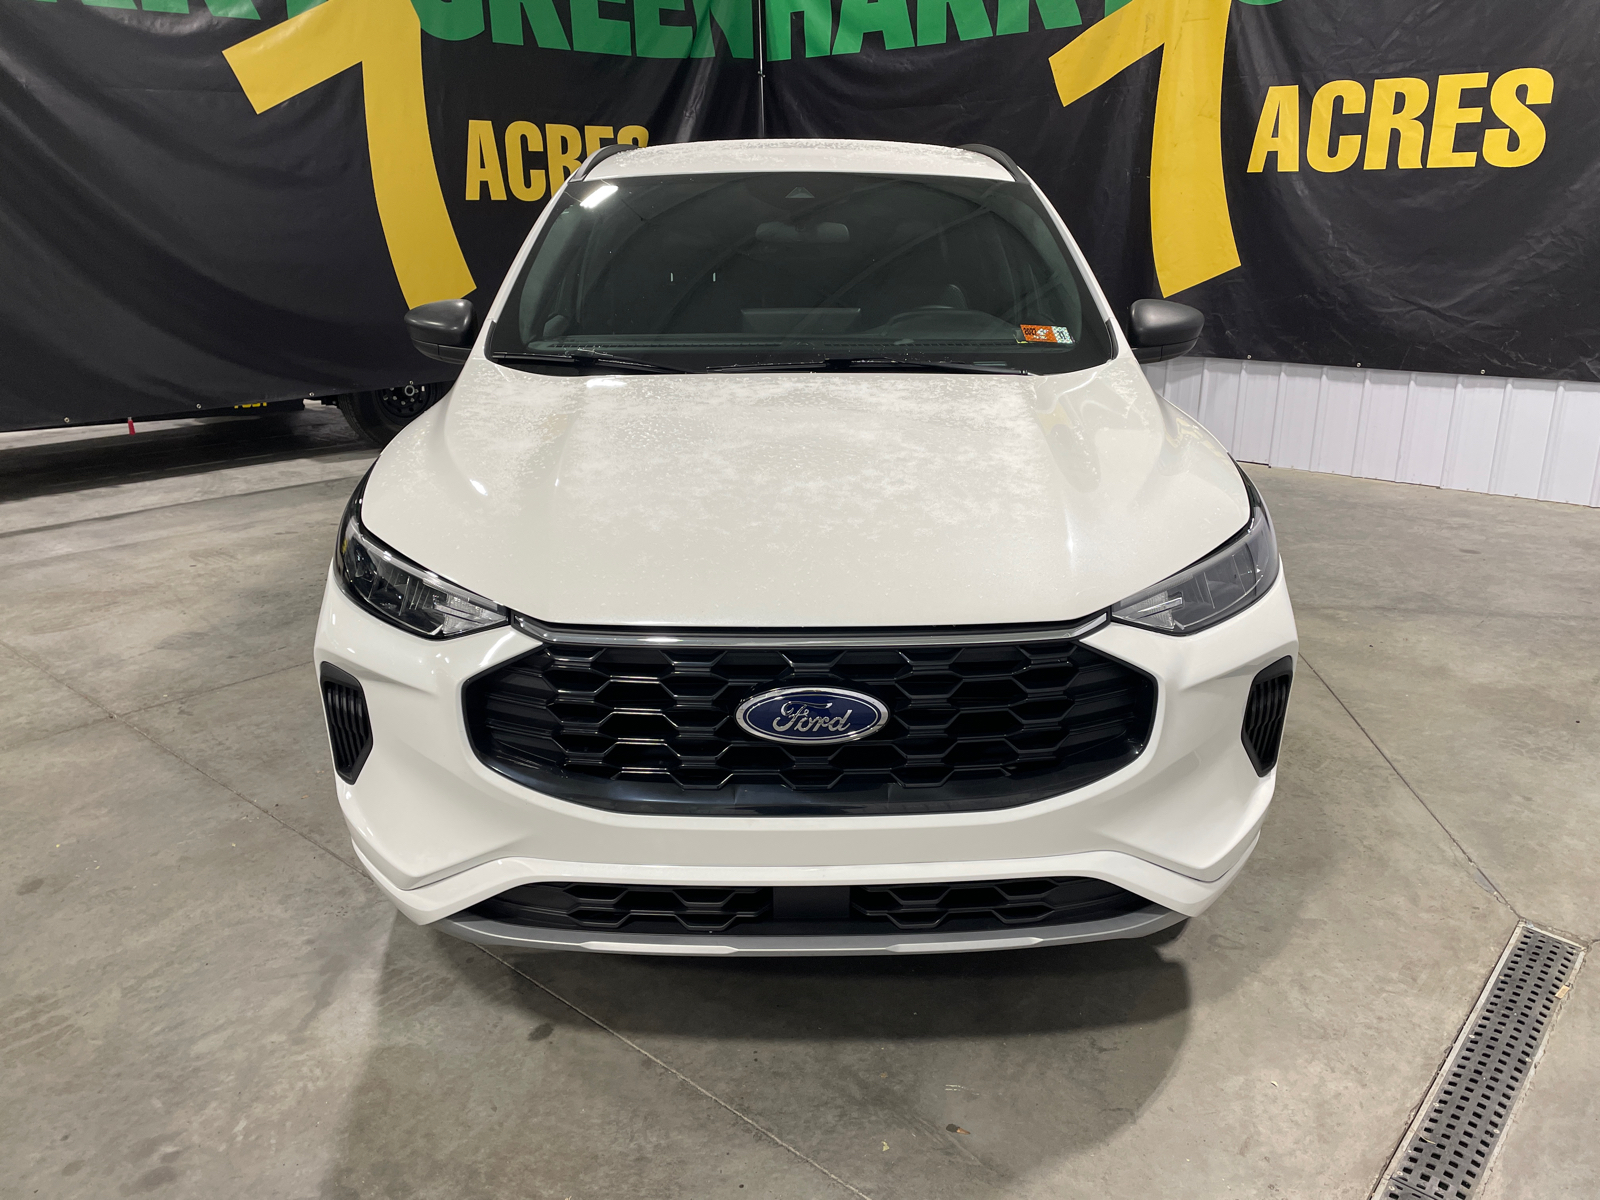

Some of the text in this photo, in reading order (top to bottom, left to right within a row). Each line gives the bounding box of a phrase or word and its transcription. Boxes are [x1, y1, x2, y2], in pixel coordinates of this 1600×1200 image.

[465, 119, 649, 202] ACR
[1049, 0, 1555, 298] 7 ACRES
[772, 701, 853, 732] Ford
